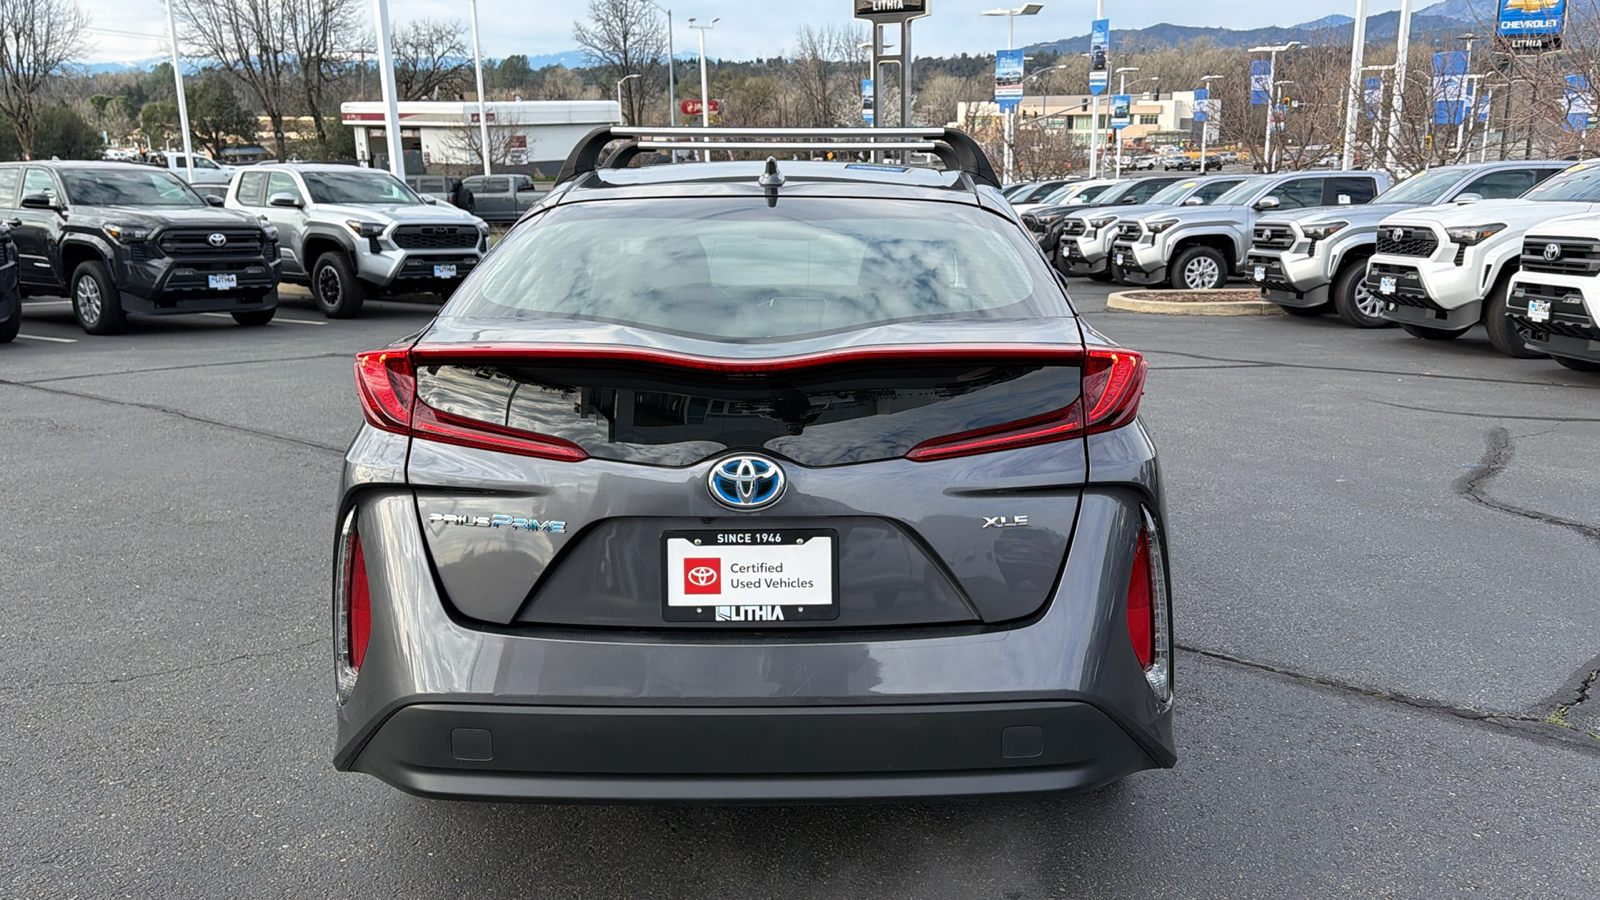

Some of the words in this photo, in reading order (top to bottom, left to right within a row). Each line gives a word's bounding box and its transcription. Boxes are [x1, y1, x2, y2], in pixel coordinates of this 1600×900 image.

[872, 0, 904, 11] LITHIA
[1501, 19, 1558, 29] CHEVROLET
[1512, 40, 1542, 48] LITHIA
[982, 515, 1028, 529] XLE
[717, 533, 752, 544] SINCE
[755, 533, 782, 543] 1946
[730, 562, 783, 574] Certified
[730, 578, 761, 589] Used
[764, 577, 814, 589] Vehicles
[731, 605, 785, 621] LITHIA
